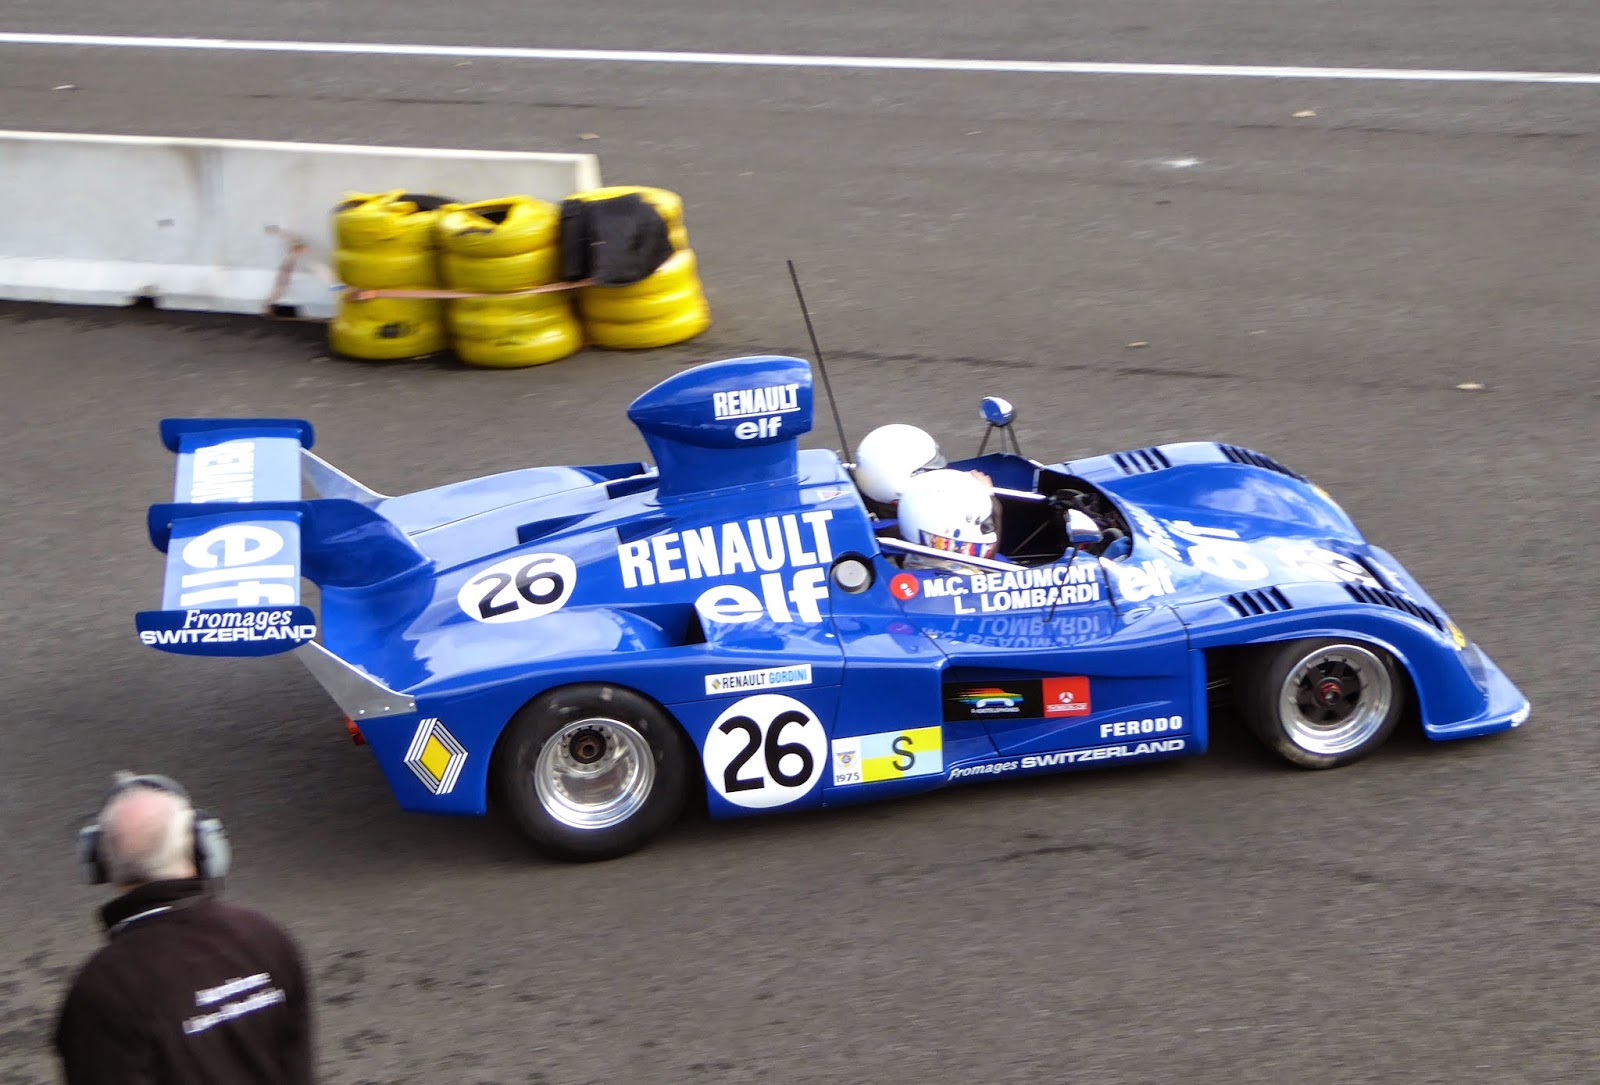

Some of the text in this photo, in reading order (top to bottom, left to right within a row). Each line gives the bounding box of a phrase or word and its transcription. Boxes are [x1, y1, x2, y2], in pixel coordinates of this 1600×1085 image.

[713, 384, 801, 420] RENAULT
[735, 416, 782, 440] elf
[617, 510, 833, 589] RENAULT
[471, 558, 565, 619] 26
[695, 567, 829, 623] elf
[970, 563, 1098, 594] BEAUMONT
[1118, 559, 1177, 602] elf
[953, 582, 1100, 615] L. LOMBARDI
[139, 624, 317, 645] SWITZERLAND
[182, 609, 292, 630] Fromages
[722, 667, 808, 689] RENAULT GORDINI
[1100, 715, 1183, 738] FERODO
[718, 710, 814, 793] 26
[892, 736, 916, 771] S
[948, 739, 1186, 781] Fromages SWITZERLAND
[836, 772, 860, 783] 1975
